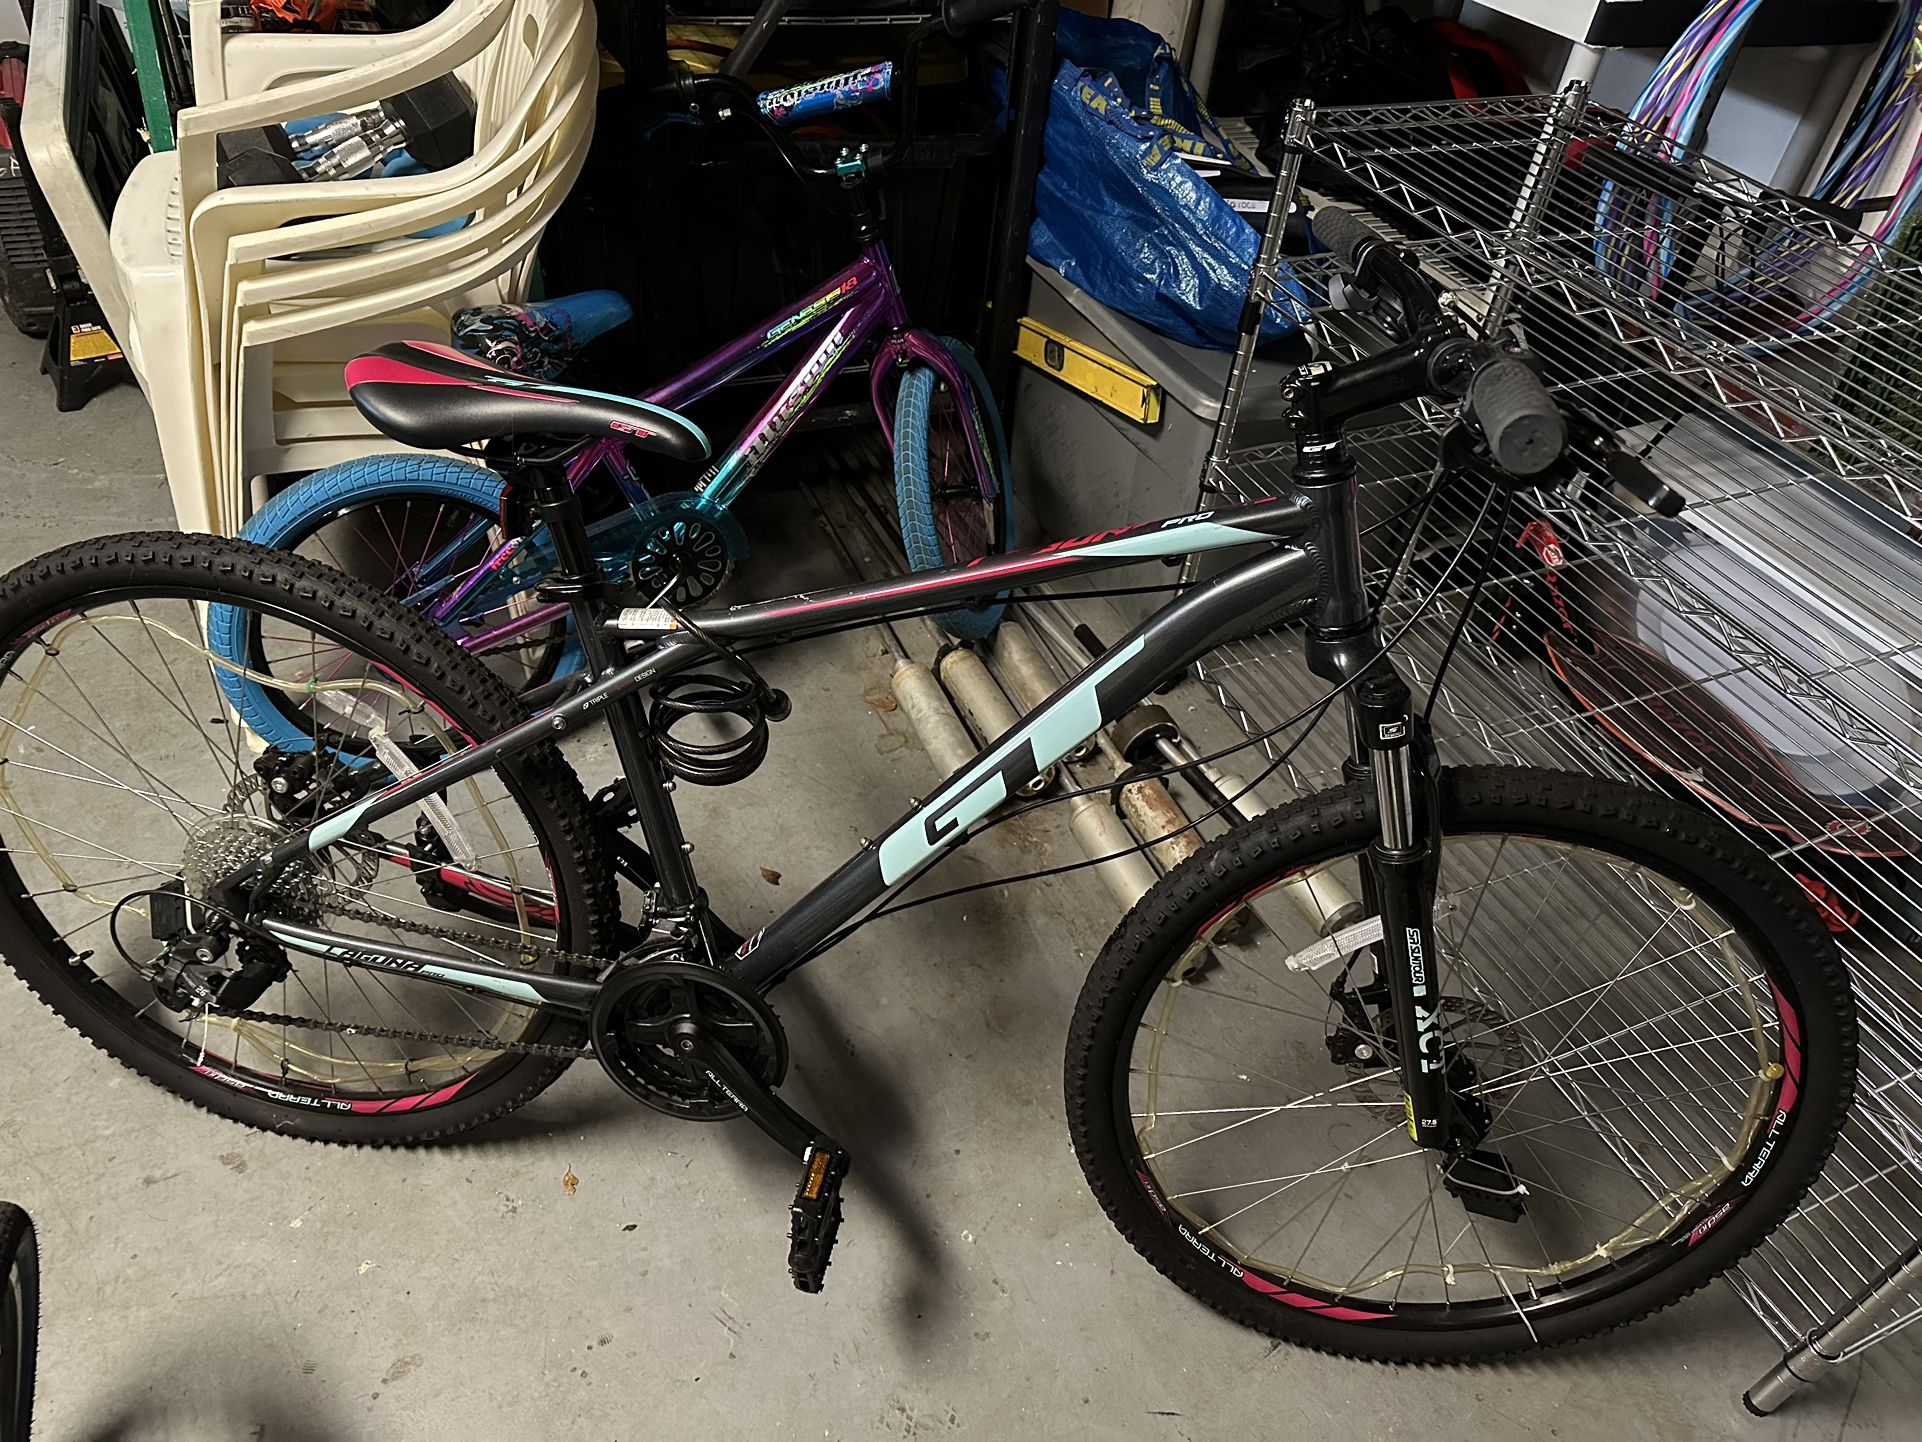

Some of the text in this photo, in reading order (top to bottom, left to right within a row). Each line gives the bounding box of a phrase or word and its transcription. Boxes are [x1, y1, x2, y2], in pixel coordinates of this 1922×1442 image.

[610, 420, 658, 439] GT
[1160, 510, 1215, 529] PRO
[588, 668, 657, 706] TRIPLE DESIGN
[878, 634, 1146, 887] GT
